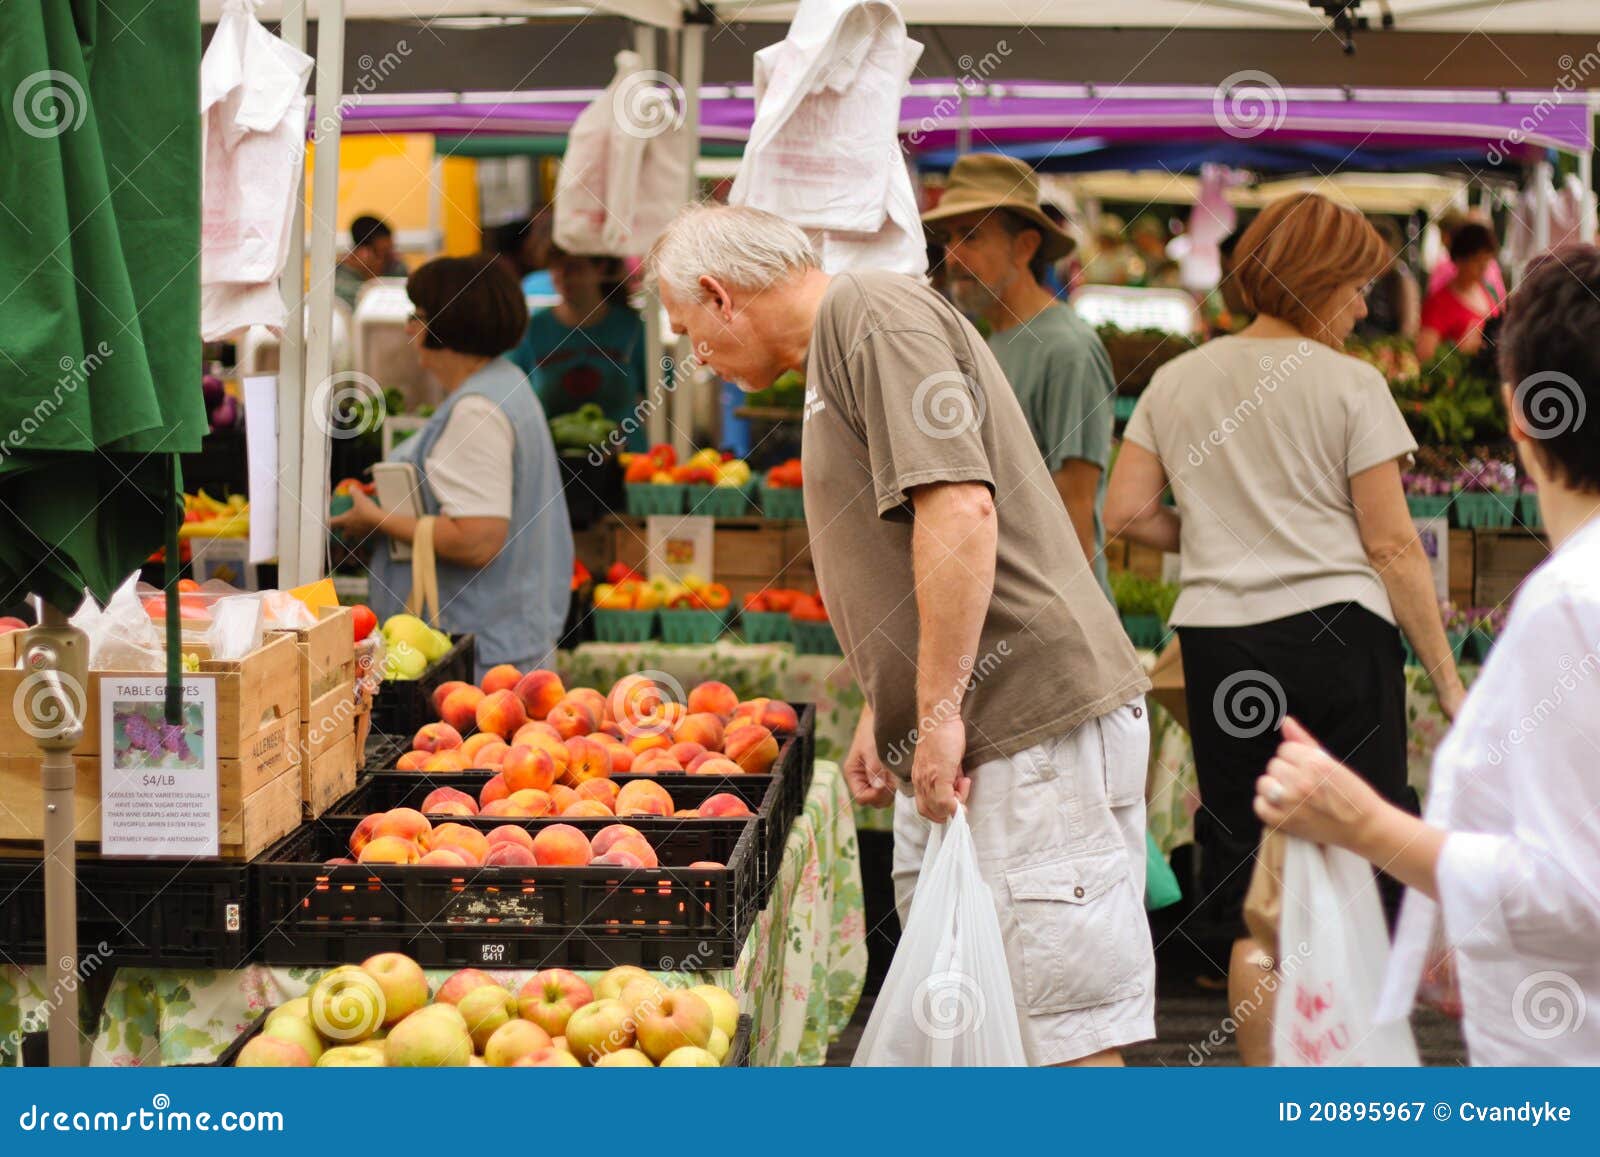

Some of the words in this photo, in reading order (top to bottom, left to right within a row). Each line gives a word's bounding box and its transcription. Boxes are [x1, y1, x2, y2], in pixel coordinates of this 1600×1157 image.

[116, 685, 151, 697] TABLE
[143, 775, 176, 786] $4/LB
[184, 791, 211, 799] USUALLY
[482, 944, 505, 953] IFCO
[483, 953, 503, 961] 6411
